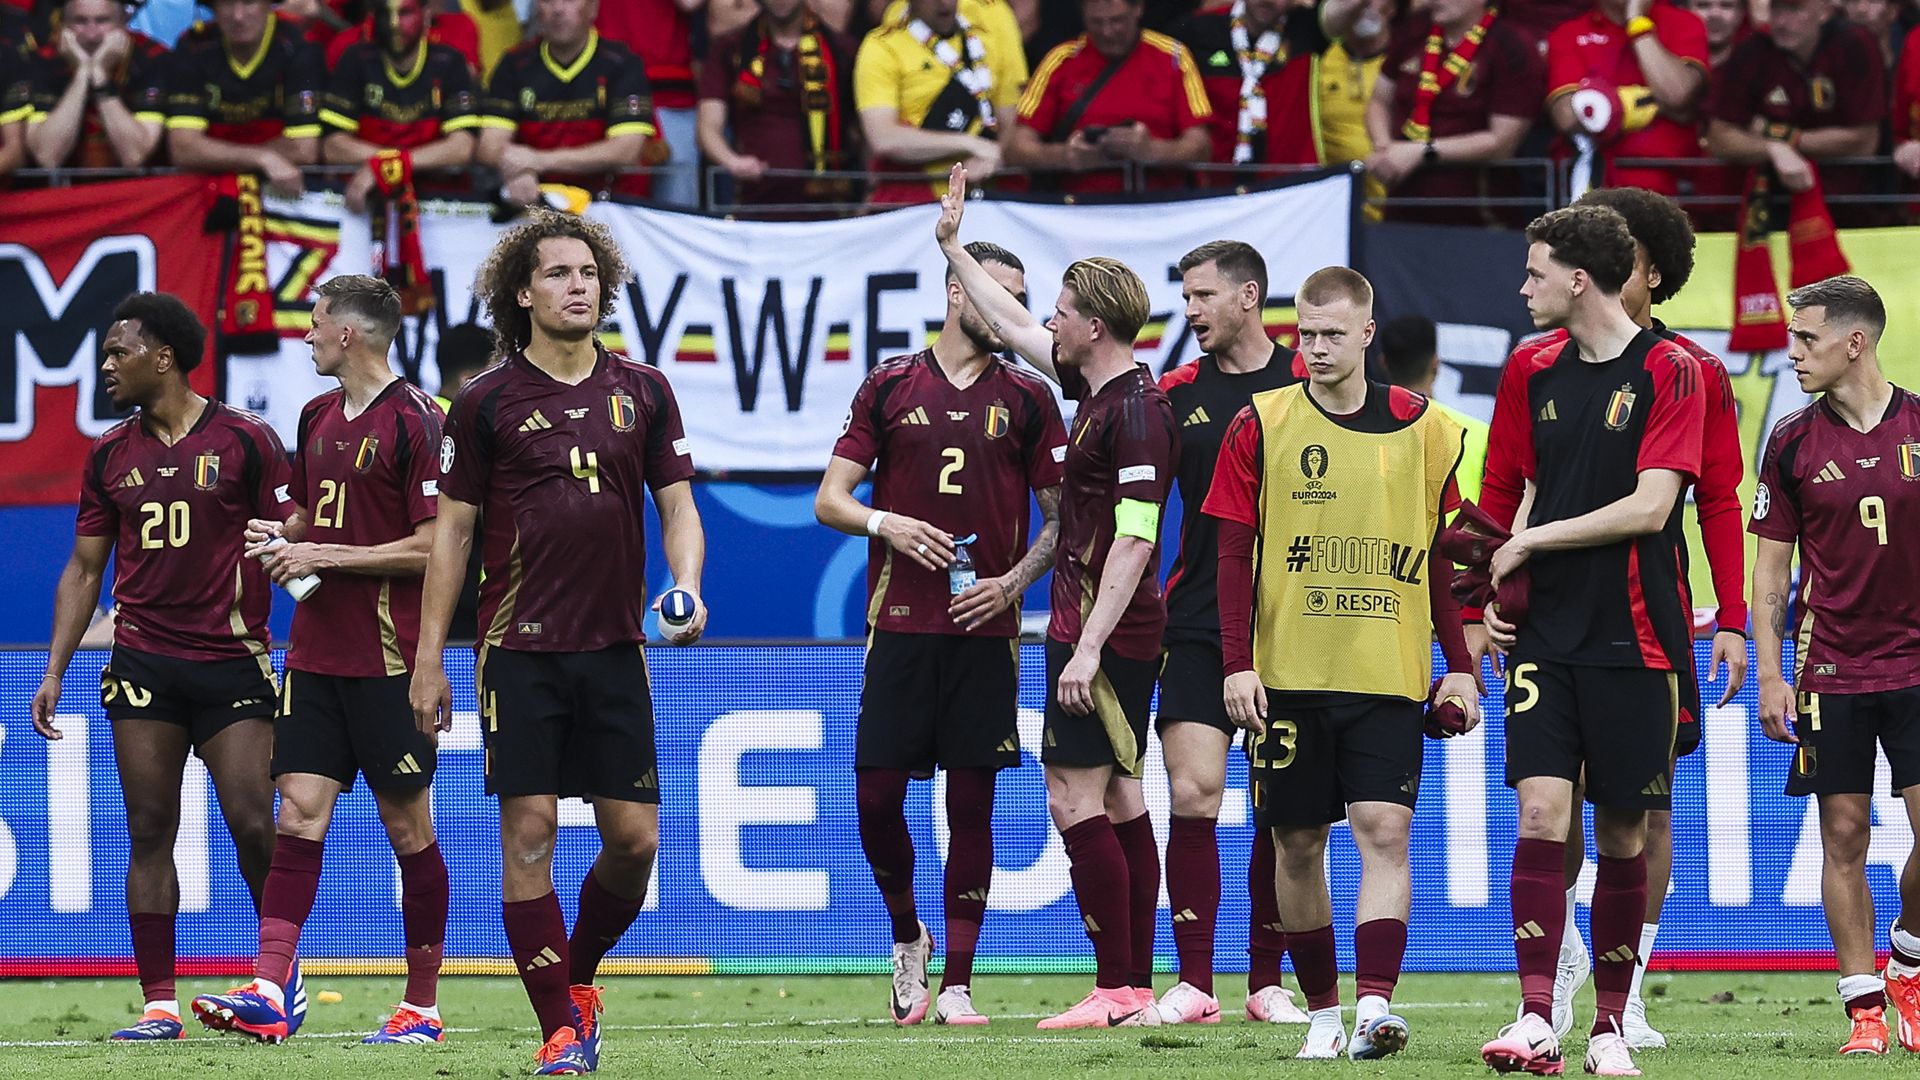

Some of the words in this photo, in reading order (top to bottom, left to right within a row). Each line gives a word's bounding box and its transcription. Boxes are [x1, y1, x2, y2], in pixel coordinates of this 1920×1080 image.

[569, 445, 600, 494] 4
[938, 446, 966, 495] 2
[139, 500, 190, 550] 20
[313, 478, 347, 529] 21
[1858, 495, 1889, 545] 9
[1285, 534, 1427, 586] #FOOTBALL
[1335, 593, 1402, 618] RESPECT
[482, 685, 498, 733] 4
[1248, 718, 1298, 770] 23
